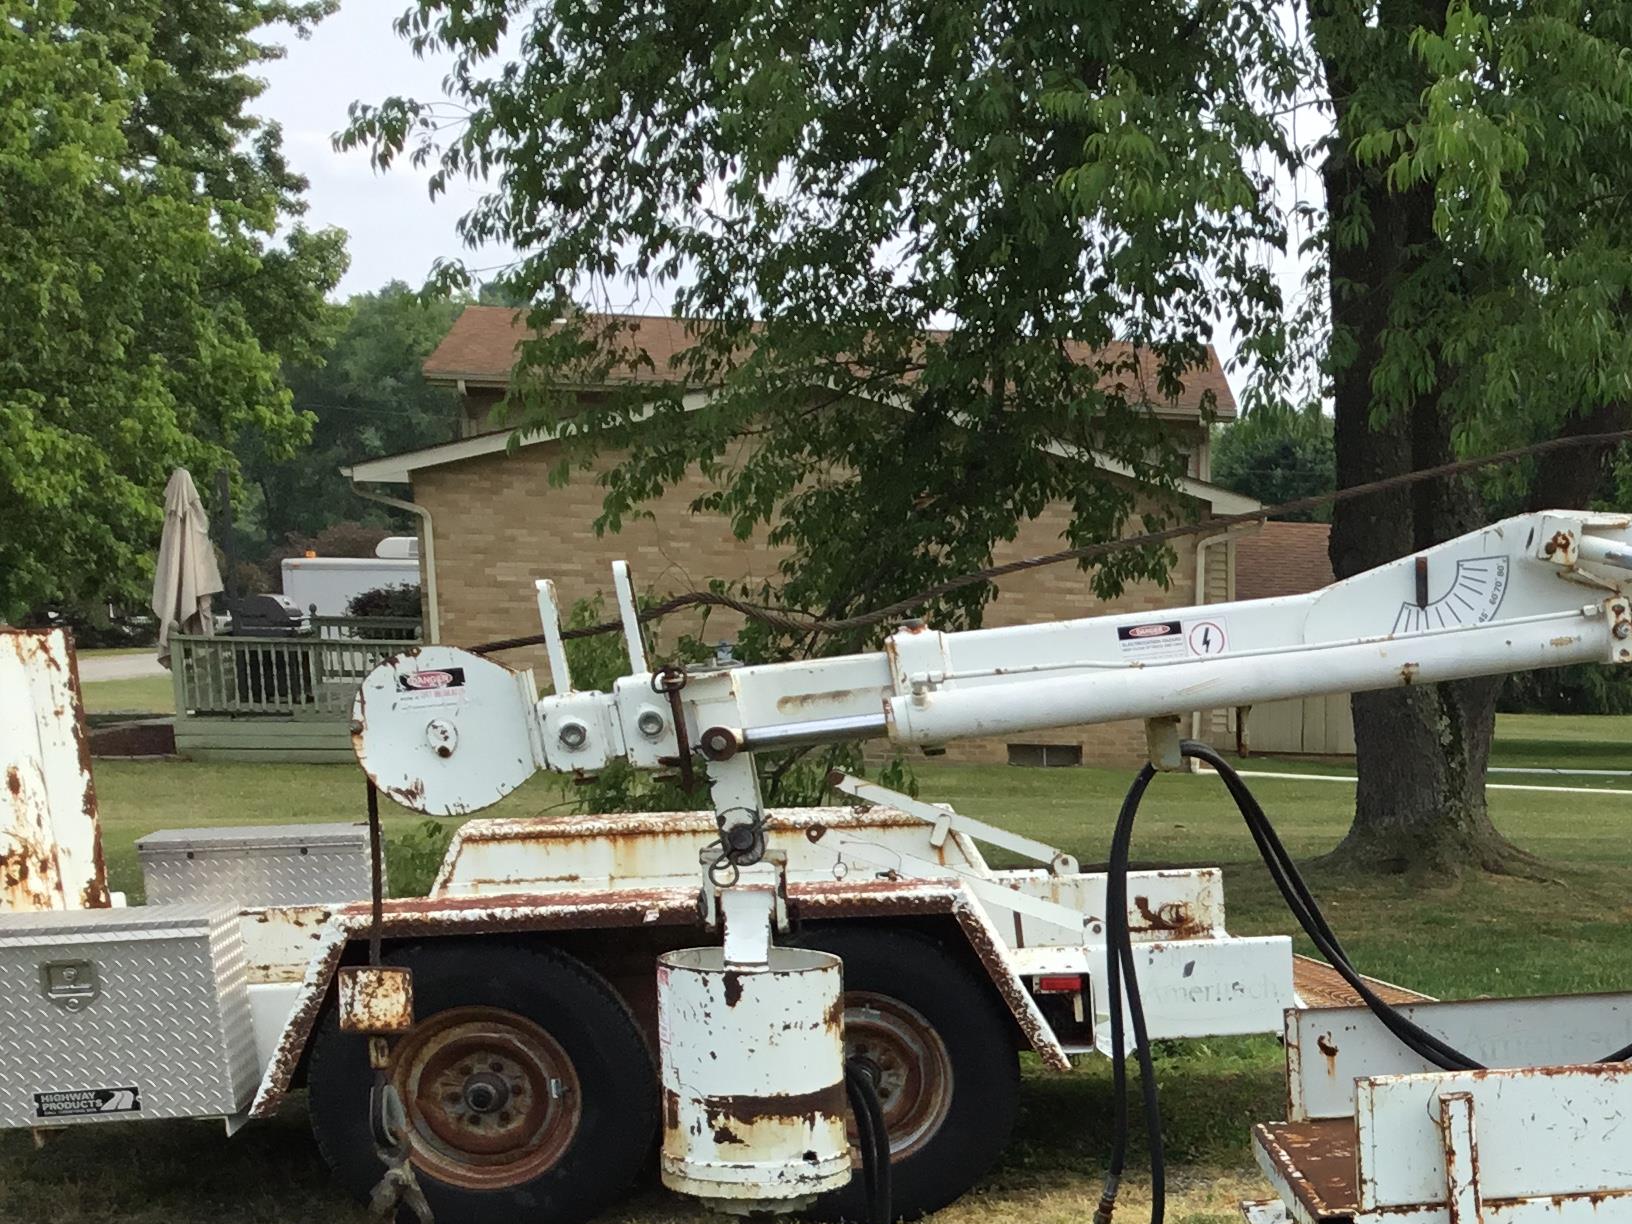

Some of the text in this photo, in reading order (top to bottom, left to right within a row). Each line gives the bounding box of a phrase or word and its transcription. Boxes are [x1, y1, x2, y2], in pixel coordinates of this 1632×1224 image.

[409, 674, 450, 686] DANGER
[40, 1091, 96, 1103] HIGHWAY
[42, 1099, 103, 1111] PRODUCTS
